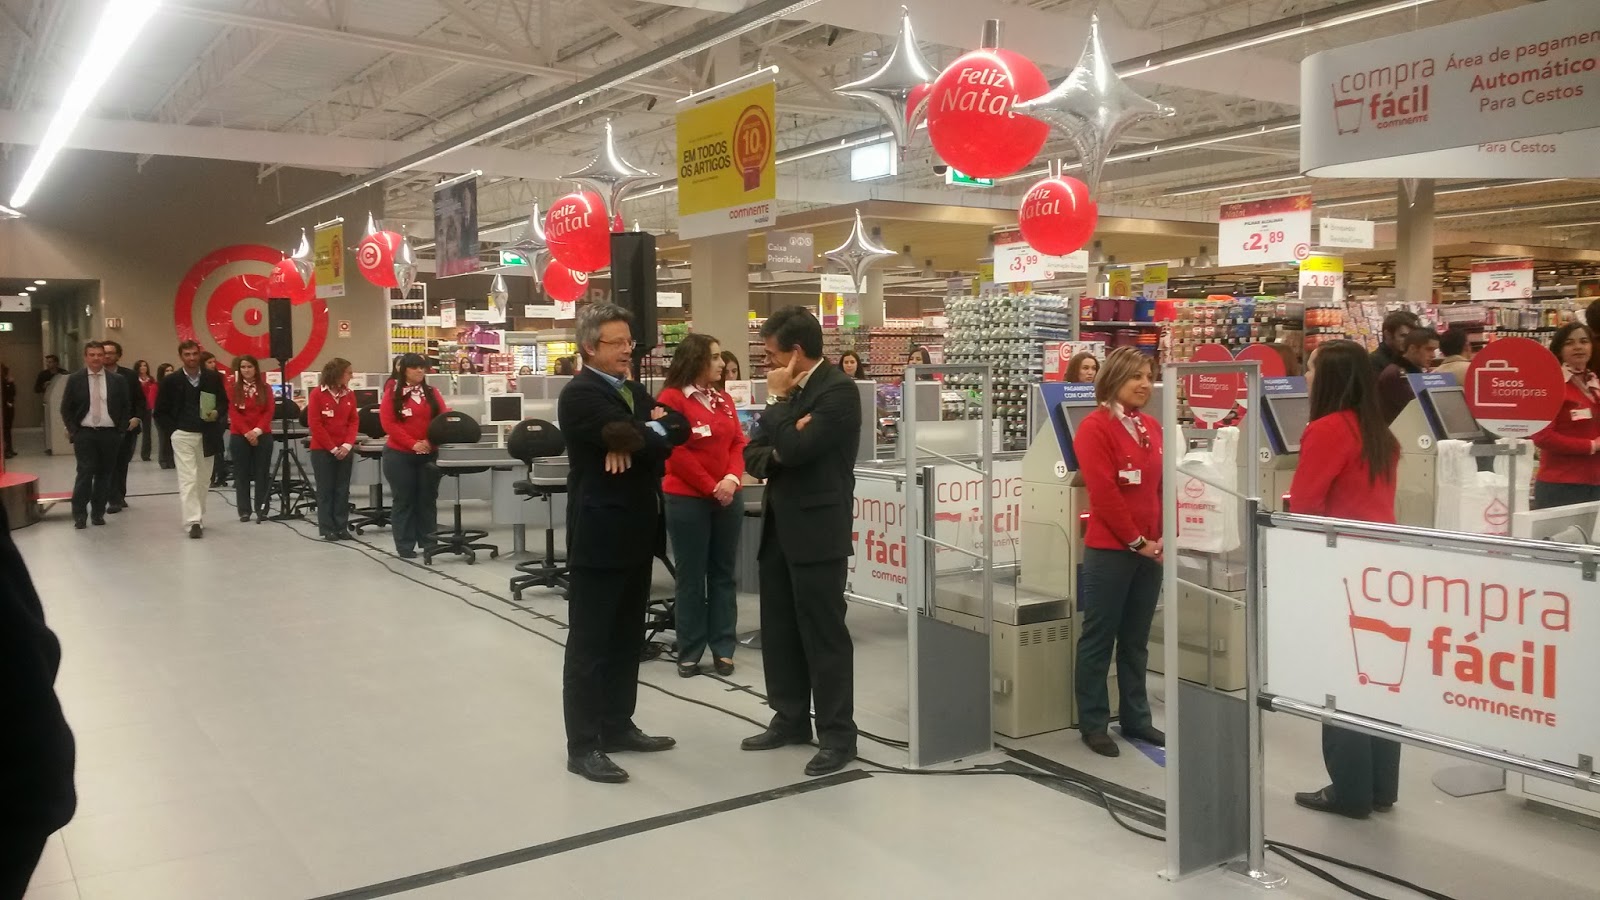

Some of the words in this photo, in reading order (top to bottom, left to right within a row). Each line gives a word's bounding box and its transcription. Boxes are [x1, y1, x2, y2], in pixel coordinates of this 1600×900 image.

[1445, 53, 1483, 72] Área
[1489, 47, 1510, 63] de
[957, 67, 1008, 88] Feliz
[1340, 57, 1435, 94] compra
[1470, 57, 1595, 93] Automático
[940, 87, 1019, 119] Natal
[1369, 84, 1429, 120] fácil
[1479, 96, 1516, 112] Para
[1522, 83, 1584, 105] Cestos
[684, 148, 696, 163] EM
[698, 140, 727, 160] TODOS
[1510, 140, 1556, 153] Cestos
[681, 165, 693, 178] OS
[694, 155, 731, 175] ARTIGOS
[551, 204, 576, 222] Feliz
[768, 242, 787, 252] Caixa
[768, 254, 801, 265] Prioritária
[1199, 374, 1217, 383] Sacos
[1491, 377, 1524, 388] Sacos
[1498, 388, 1547, 399] compras
[1260, 451, 1269, 459] 12
[1056, 465, 1065, 474] 13
[853, 495, 919, 533] ompr
[969, 503, 1020, 534] fcil
[865, 529, 907, 568] fáci
[872, 569, 908, 585] CONTINEN
[1362, 566, 1570, 633] compra
[1427, 626, 1556, 699] fácil
[1443, 691, 1556, 727] CONTINENTE
